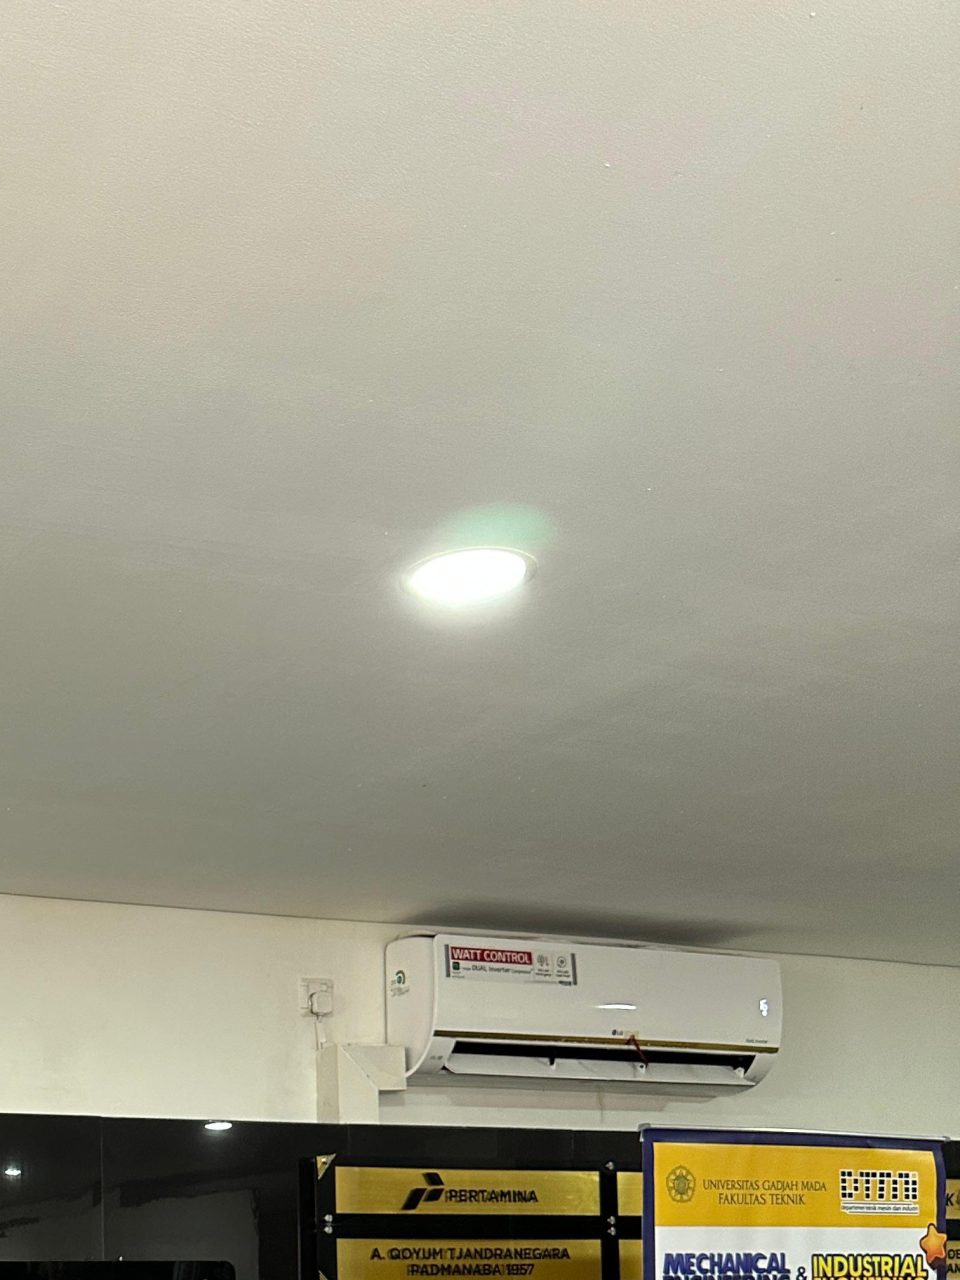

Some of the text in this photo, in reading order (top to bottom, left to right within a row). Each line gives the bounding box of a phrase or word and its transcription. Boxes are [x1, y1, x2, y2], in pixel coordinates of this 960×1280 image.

[451, 948, 531, 964] WATT CONTROL
[702, 1179, 827, 1193] UNIVERSITAS GADJAH MADA
[446, 1188, 539, 1203] PERTAMINA
[718, 1193, 806, 1205] FAKULTAS TEKNIK
[370, 1247, 571, 1260] A. QOYUM TJANDRANEGARA
[408, 1264, 501, 1276] PADMANABA
[663, 1252, 791, 1275] MECHANICAL
[812, 1254, 928, 1278] INDUSTRIAL
